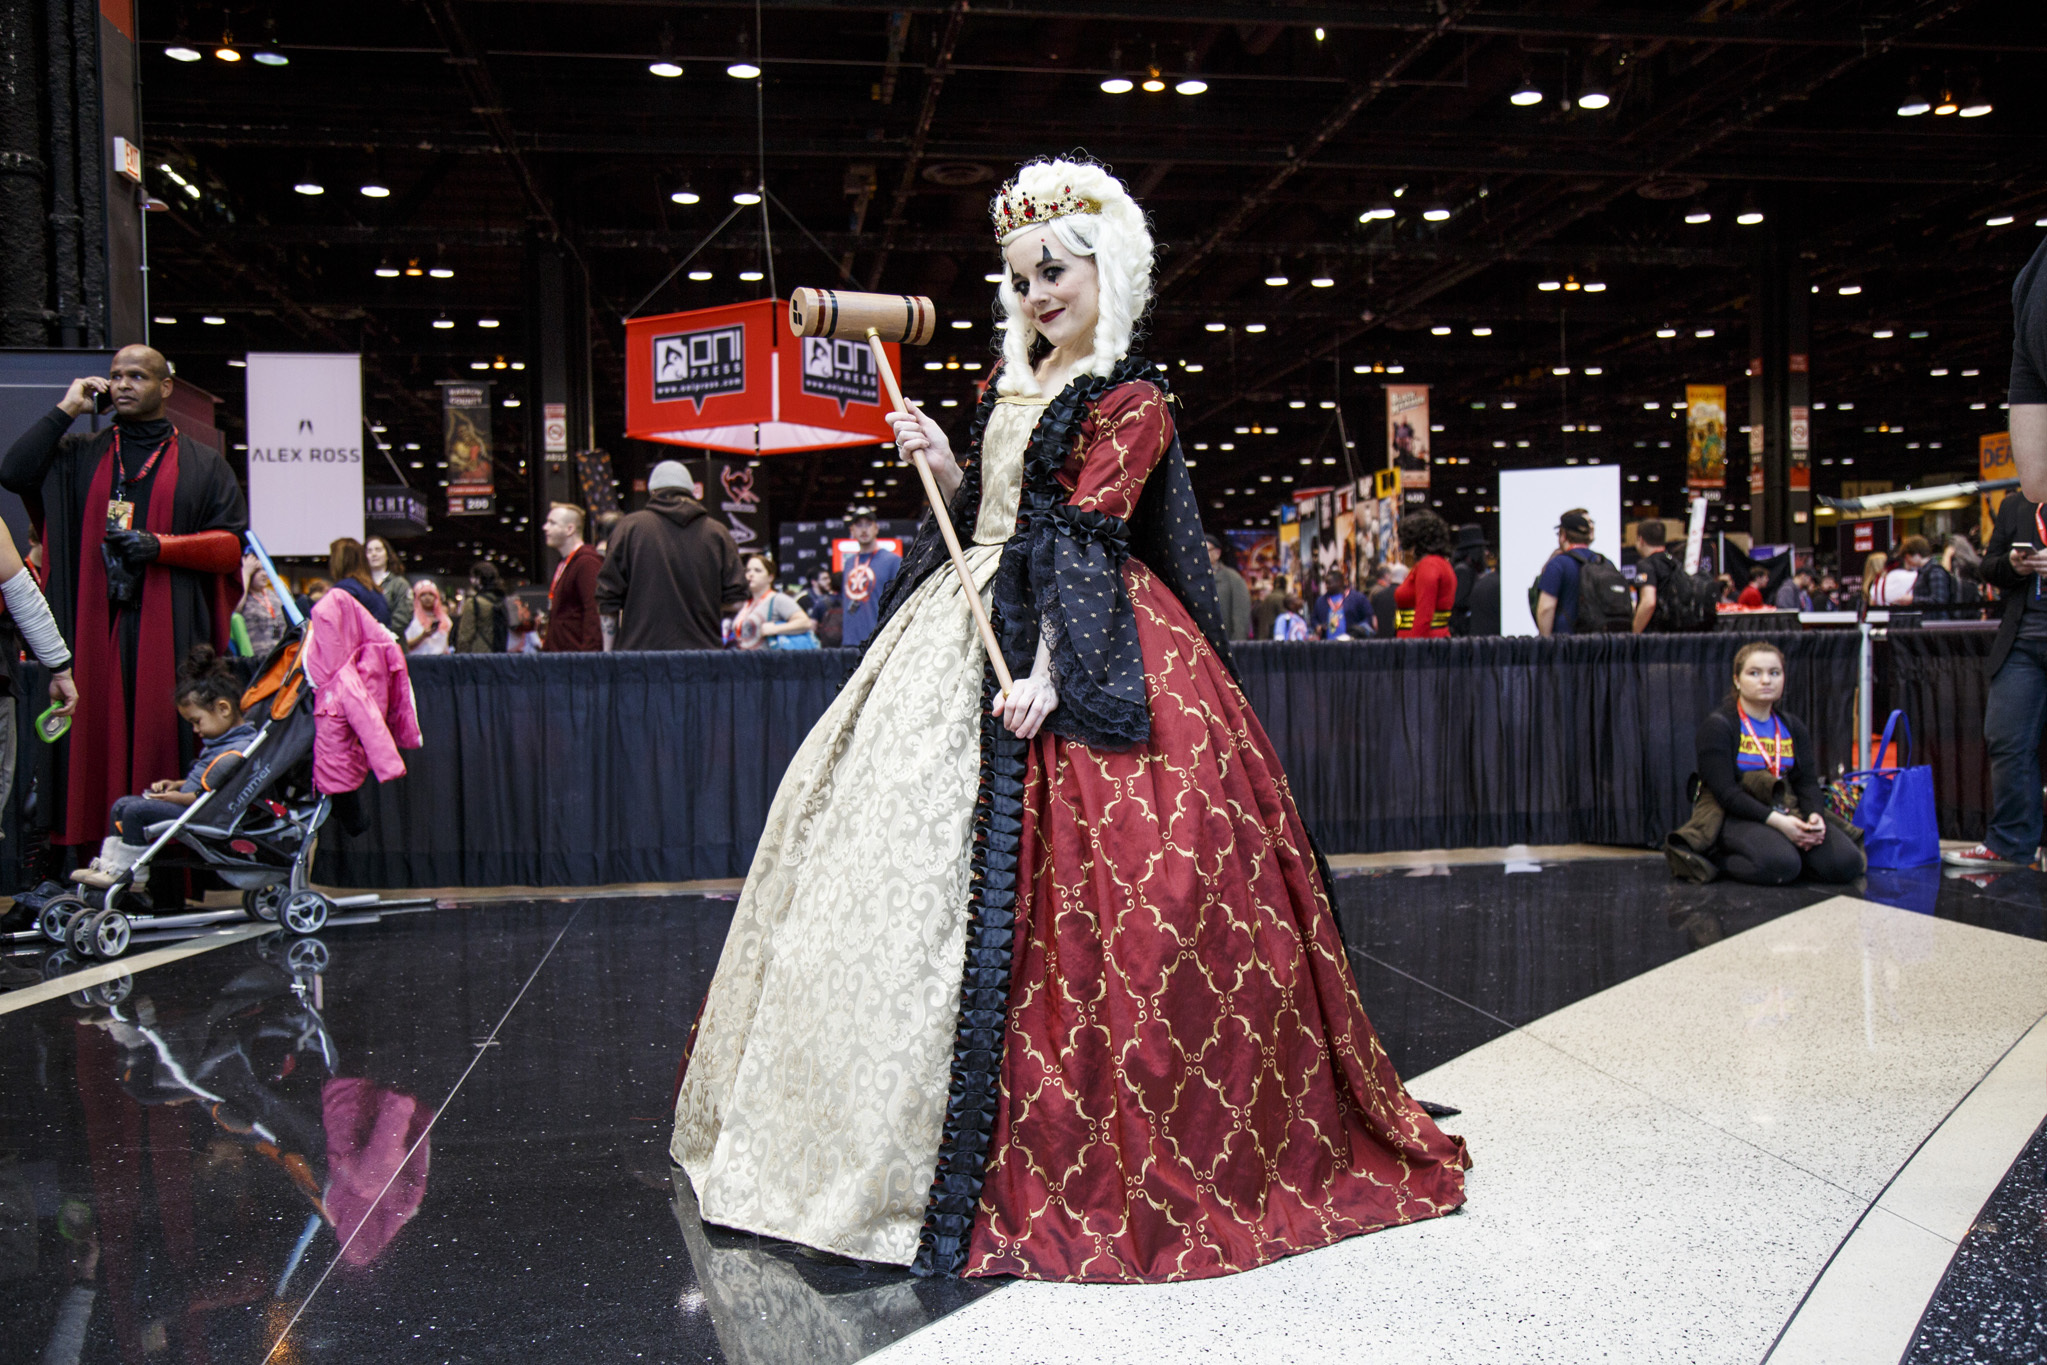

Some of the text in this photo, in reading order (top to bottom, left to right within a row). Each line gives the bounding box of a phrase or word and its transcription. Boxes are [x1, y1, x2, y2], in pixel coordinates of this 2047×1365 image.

[689, 330, 741, 367] ONI
[690, 362, 741, 379] PRESS
[835, 370, 877, 387] PRESS
[657, 377, 741, 395] www.onipress.com
[252, 448, 360, 463] ALEX ROSS
[1983, 445, 2013, 468] DEA
[366, 496, 405, 512] IGHT
[466, 498, 489, 510] 200
[228, 763, 271, 814] summer
